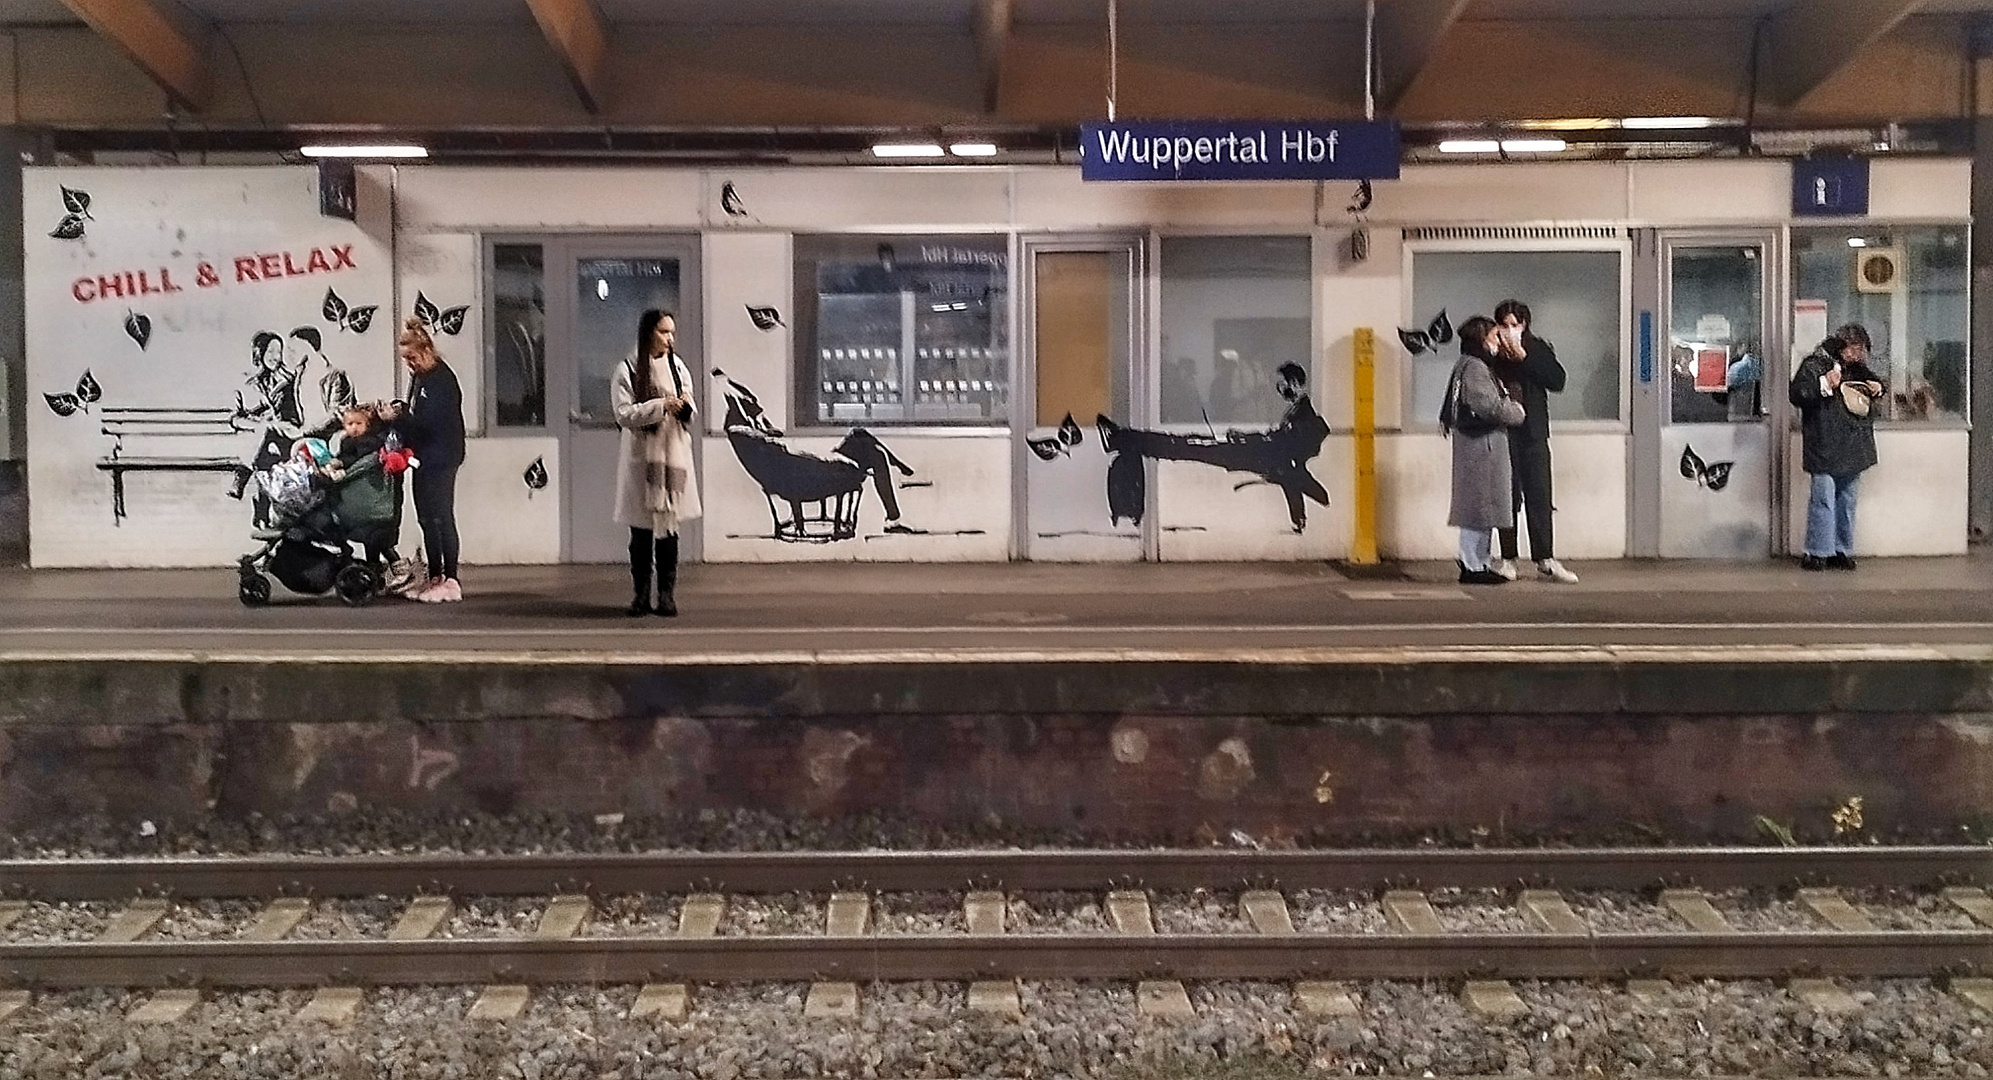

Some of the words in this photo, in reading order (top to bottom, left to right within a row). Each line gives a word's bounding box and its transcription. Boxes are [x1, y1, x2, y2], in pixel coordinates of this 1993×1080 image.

[1098, 130, 1269, 169] Wuppertal
[1281, 129, 1339, 163] Hbf
[72, 267, 182, 303] CHILL
[196, 261, 220, 288] &
[234, 244, 356, 283] RELAX
